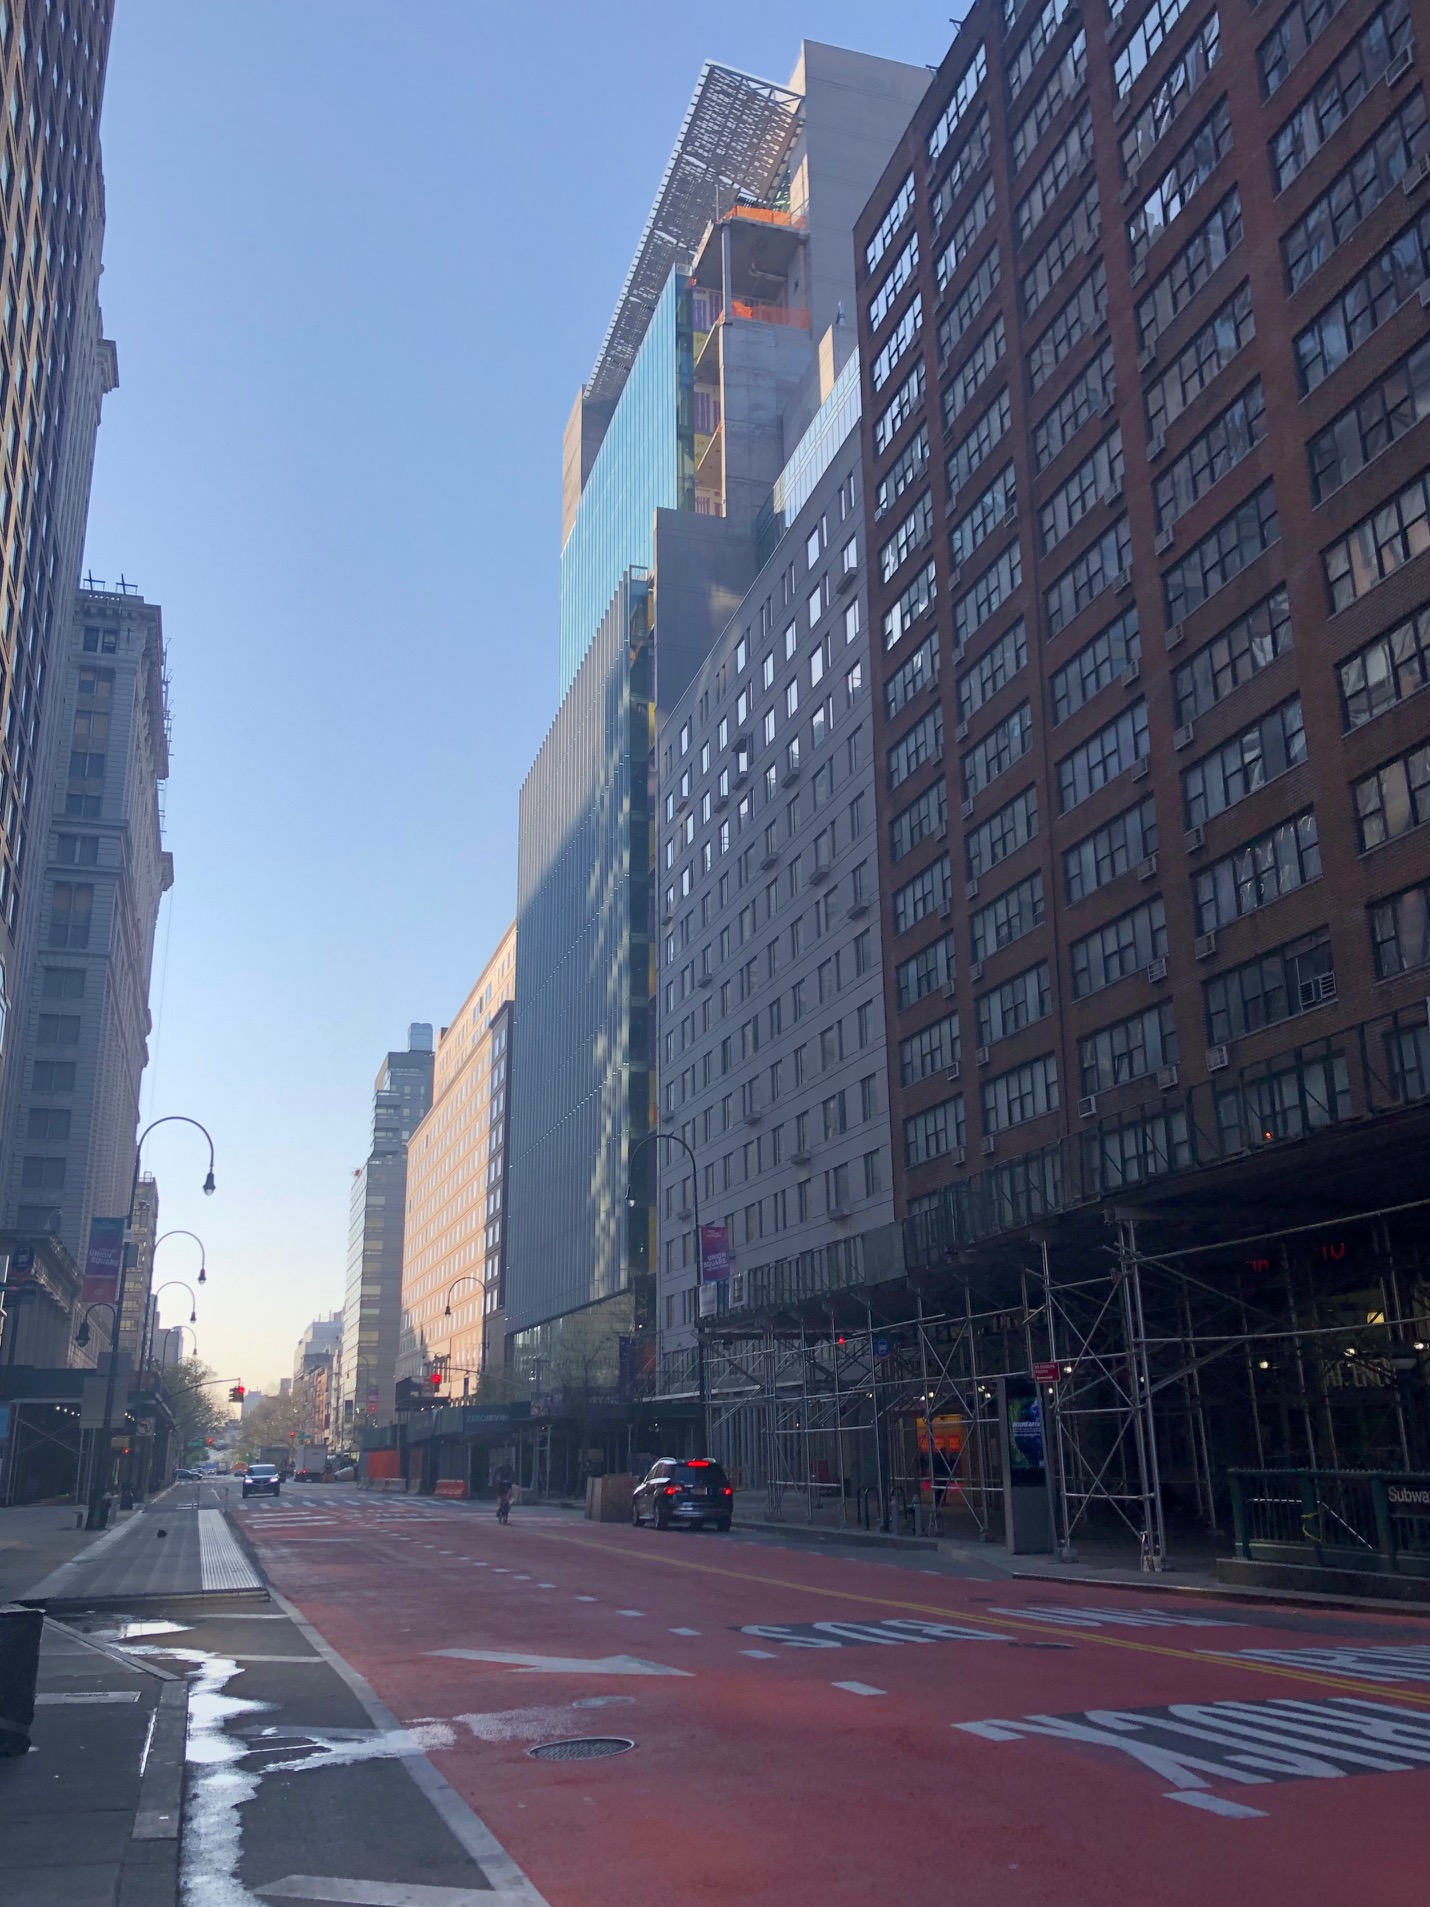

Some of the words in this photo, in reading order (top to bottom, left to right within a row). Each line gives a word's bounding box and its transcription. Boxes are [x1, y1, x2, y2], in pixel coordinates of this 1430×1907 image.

[89, 1249, 112, 1259] UNION
[707, 1251, 727, 1261] UNION
[90, 1257, 118, 1267] SQUARE
[703, 1257, 727, 1269] SQUARE
[1388, 1486, 1430, 1503] Subwa
[741, 1619, 1018, 1648] BUS
[983, 1697, 1430, 1788] RUCK
